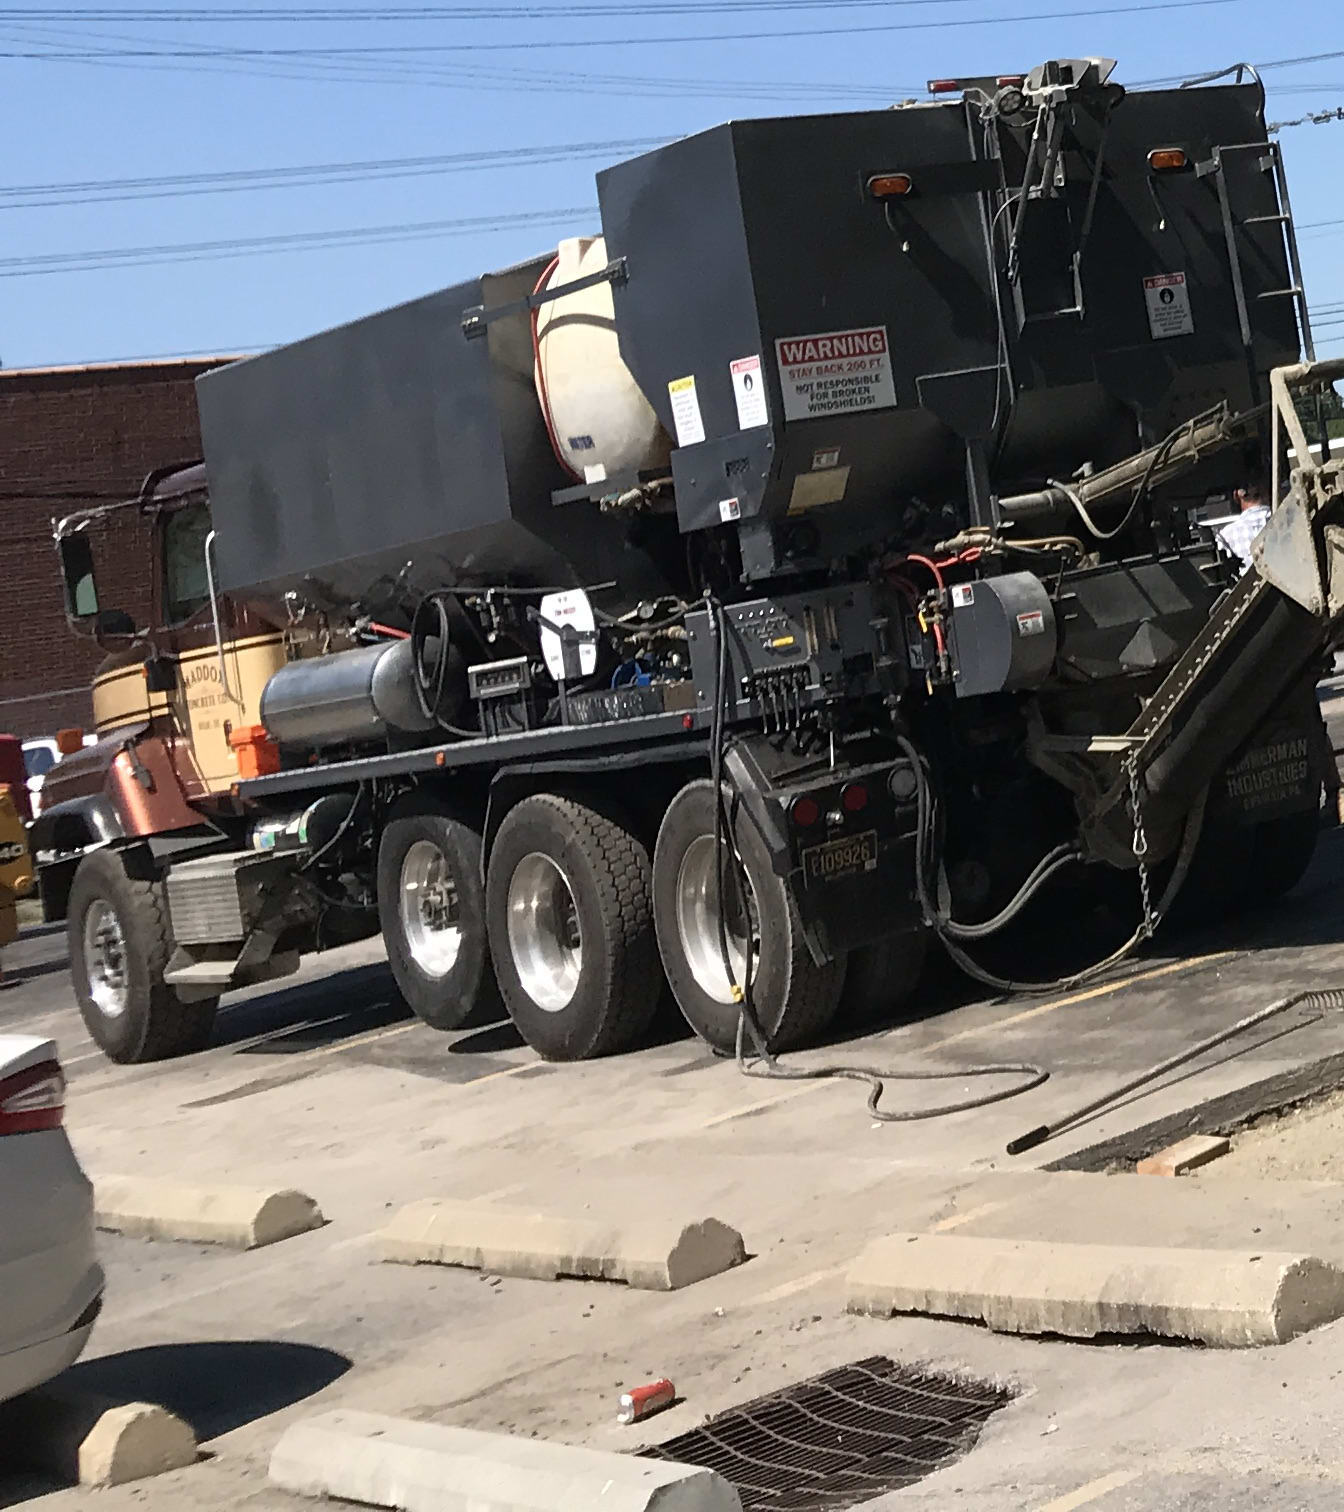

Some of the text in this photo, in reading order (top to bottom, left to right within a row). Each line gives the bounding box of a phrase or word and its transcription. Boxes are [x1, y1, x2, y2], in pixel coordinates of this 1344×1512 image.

[783, 333, 883, 362] WARNING
[788, 368, 813, 380] STAY
[816, 363, 843, 376] BACK
[847, 360, 867, 372] 200
[795, 374, 881, 394] NOT RESPONSIBLE
[810, 386, 871, 402] FOR BROKEN
[808, 395, 876, 412] WINDSHIELDS!
[1227, 760, 1307, 798] INDUSTRIES
